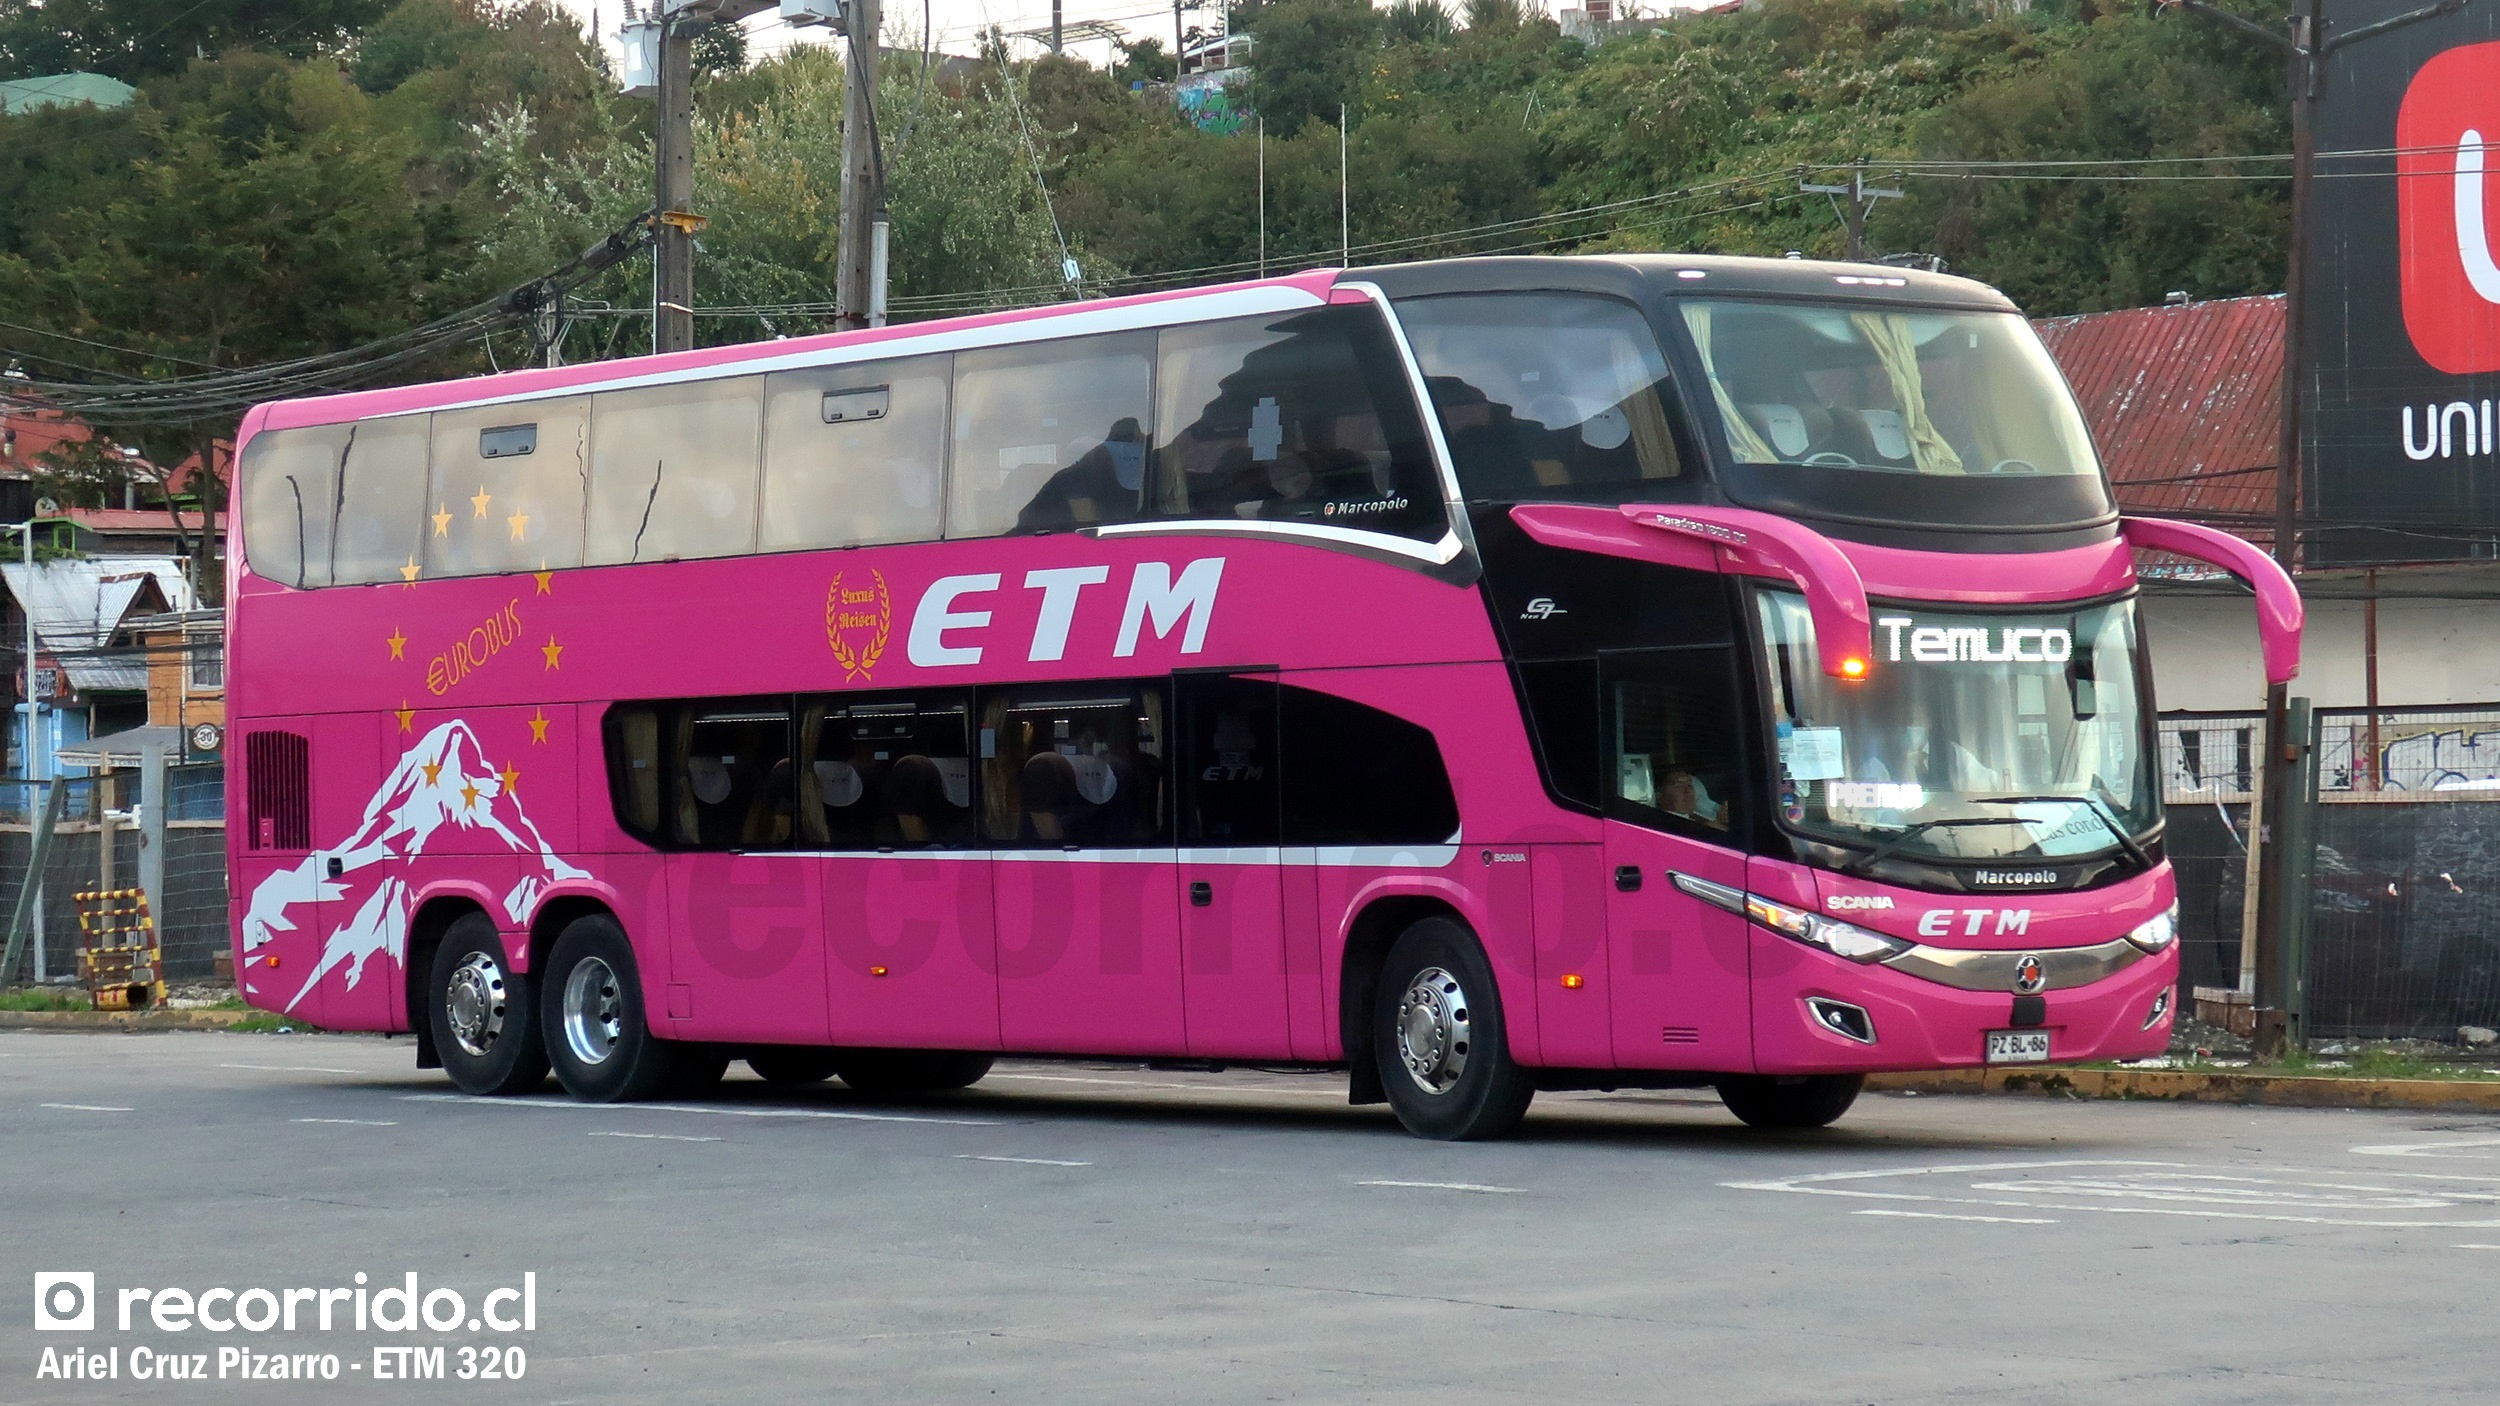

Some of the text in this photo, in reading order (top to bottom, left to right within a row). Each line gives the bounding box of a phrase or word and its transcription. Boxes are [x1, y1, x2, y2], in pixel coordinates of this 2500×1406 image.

[1338, 497, 1408, 515] Marcopolo
[907, 557, 1226, 667] ETM
[1878, 618, 2073, 661] Temuco
[1494, 853, 1526, 862] SCANIA
[1975, 870, 2057, 885] Marcopolo
[1827, 896, 1895, 910] SCANIA
[1918, 909, 2032, 936] ETM
